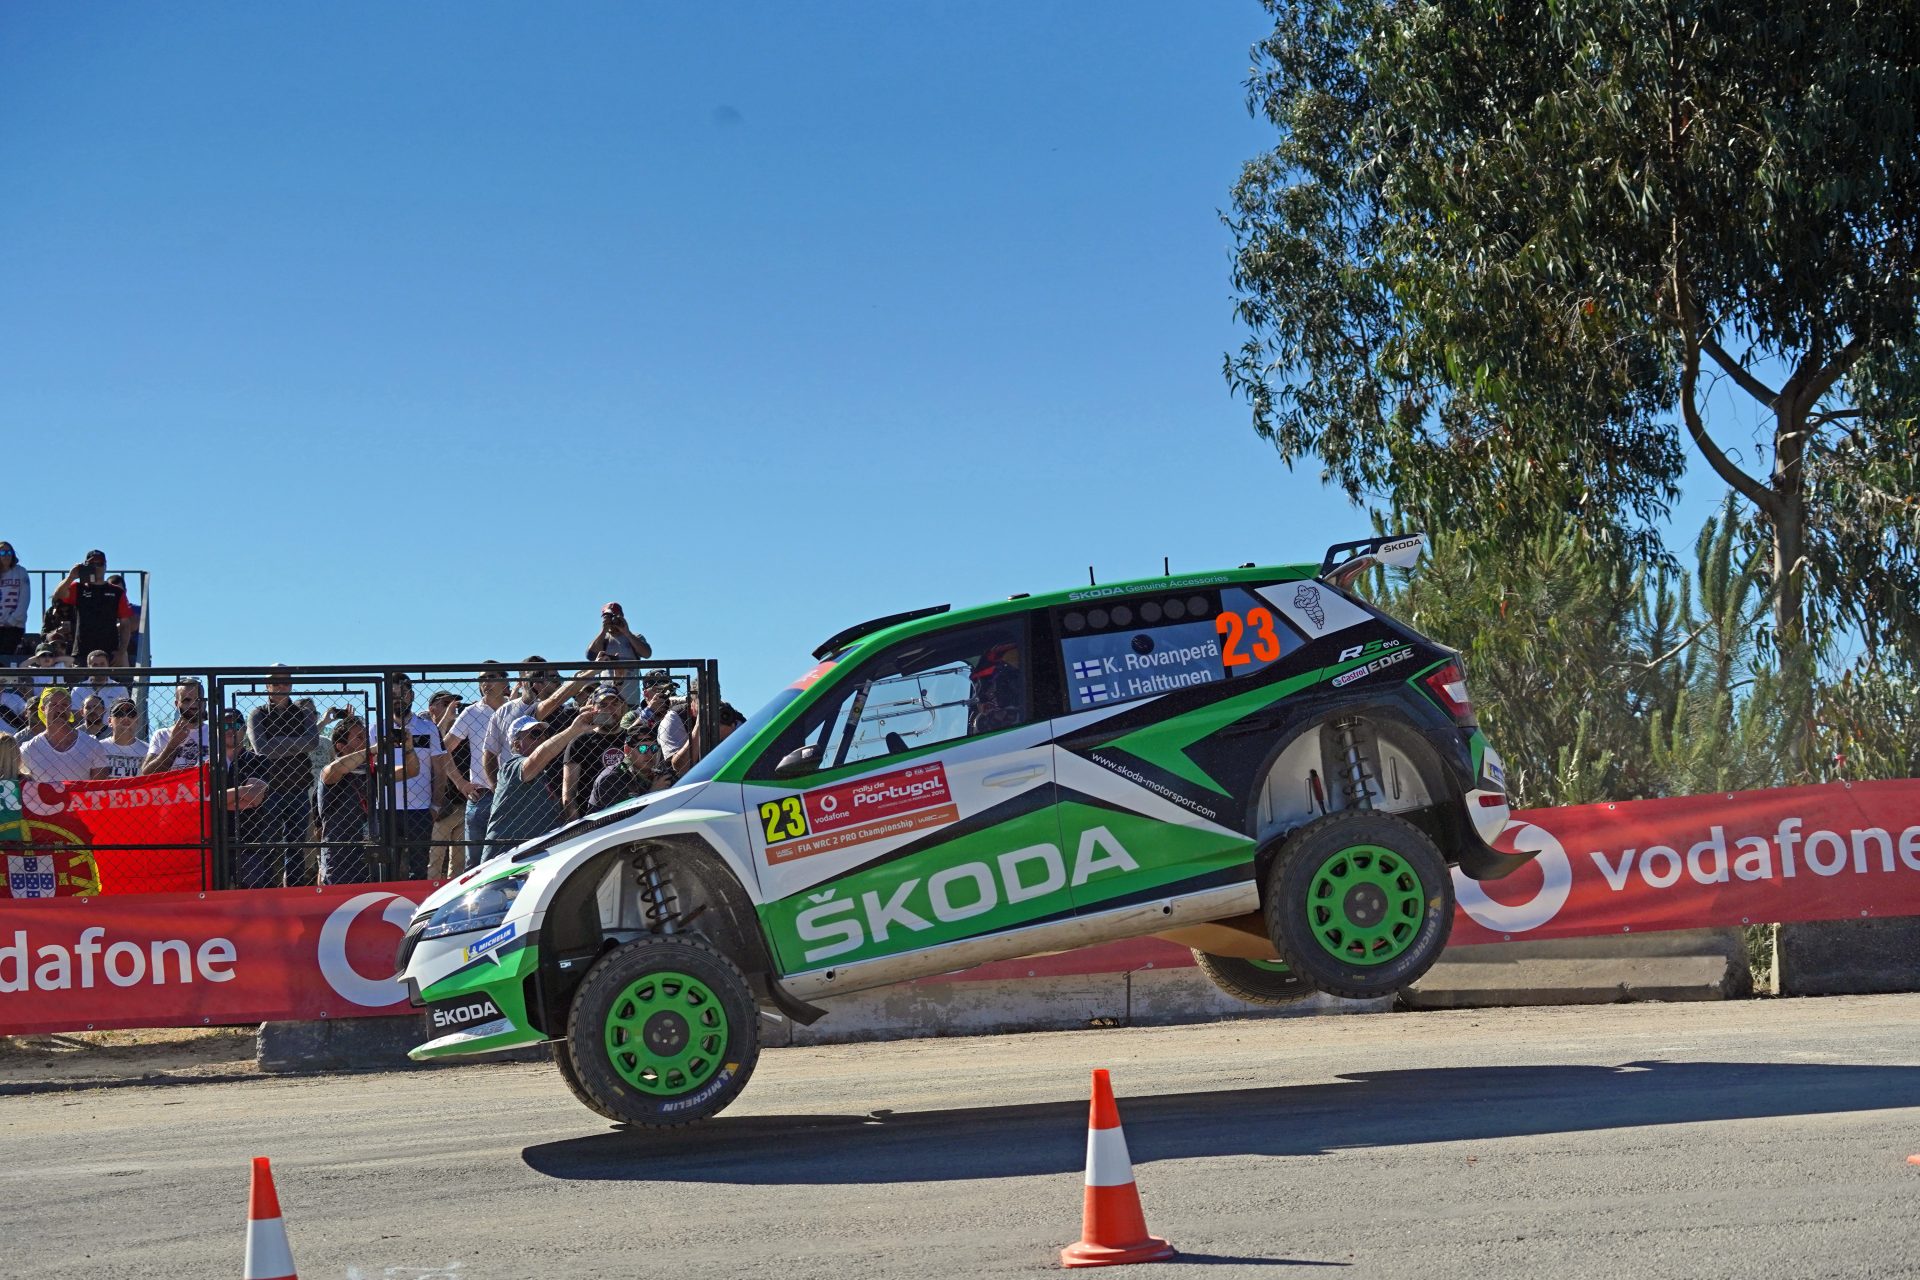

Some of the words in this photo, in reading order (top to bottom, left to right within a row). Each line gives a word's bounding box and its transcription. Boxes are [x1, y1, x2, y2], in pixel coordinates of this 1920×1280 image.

[1125, 582, 1168, 593] Genuine
[1170, 575, 1229, 588] Accessories
[1215, 607, 1281, 667] 23
[1338, 639, 1384, 663] R5
[1383, 640, 1400, 649] evo
[1103, 657, 1122, 674] K.
[1124, 640, 1218, 670] Rovanperä
[1341, 668, 1367, 684] Castrol
[1367, 648, 1415, 673] EDGE
[1110, 681, 1126, 699] J.
[1128, 669, 1212, 696] Halttunen
[852, 784, 873, 794] rally
[853, 776, 943, 807] Portugal
[931, 789, 945, 797] 2019
[1092, 753, 1216, 819] www.skoda-motorsport.com
[760, 797, 806, 843] 23
[814, 811, 850, 824] vodafone
[797, 843, 812, 853] FIA
[813, 838, 832, 850] WRC
[832, 836, 839, 845] 2
[840, 833, 857, 843] PRO
[858, 819, 914, 838] Championship
[795, 825, 1141, 963] ŠKODA
[478, 928, 512, 952] MICHELIN
[433, 1001, 498, 1028] ŠKODA
[662, 1080, 722, 1112] MICHELIN
